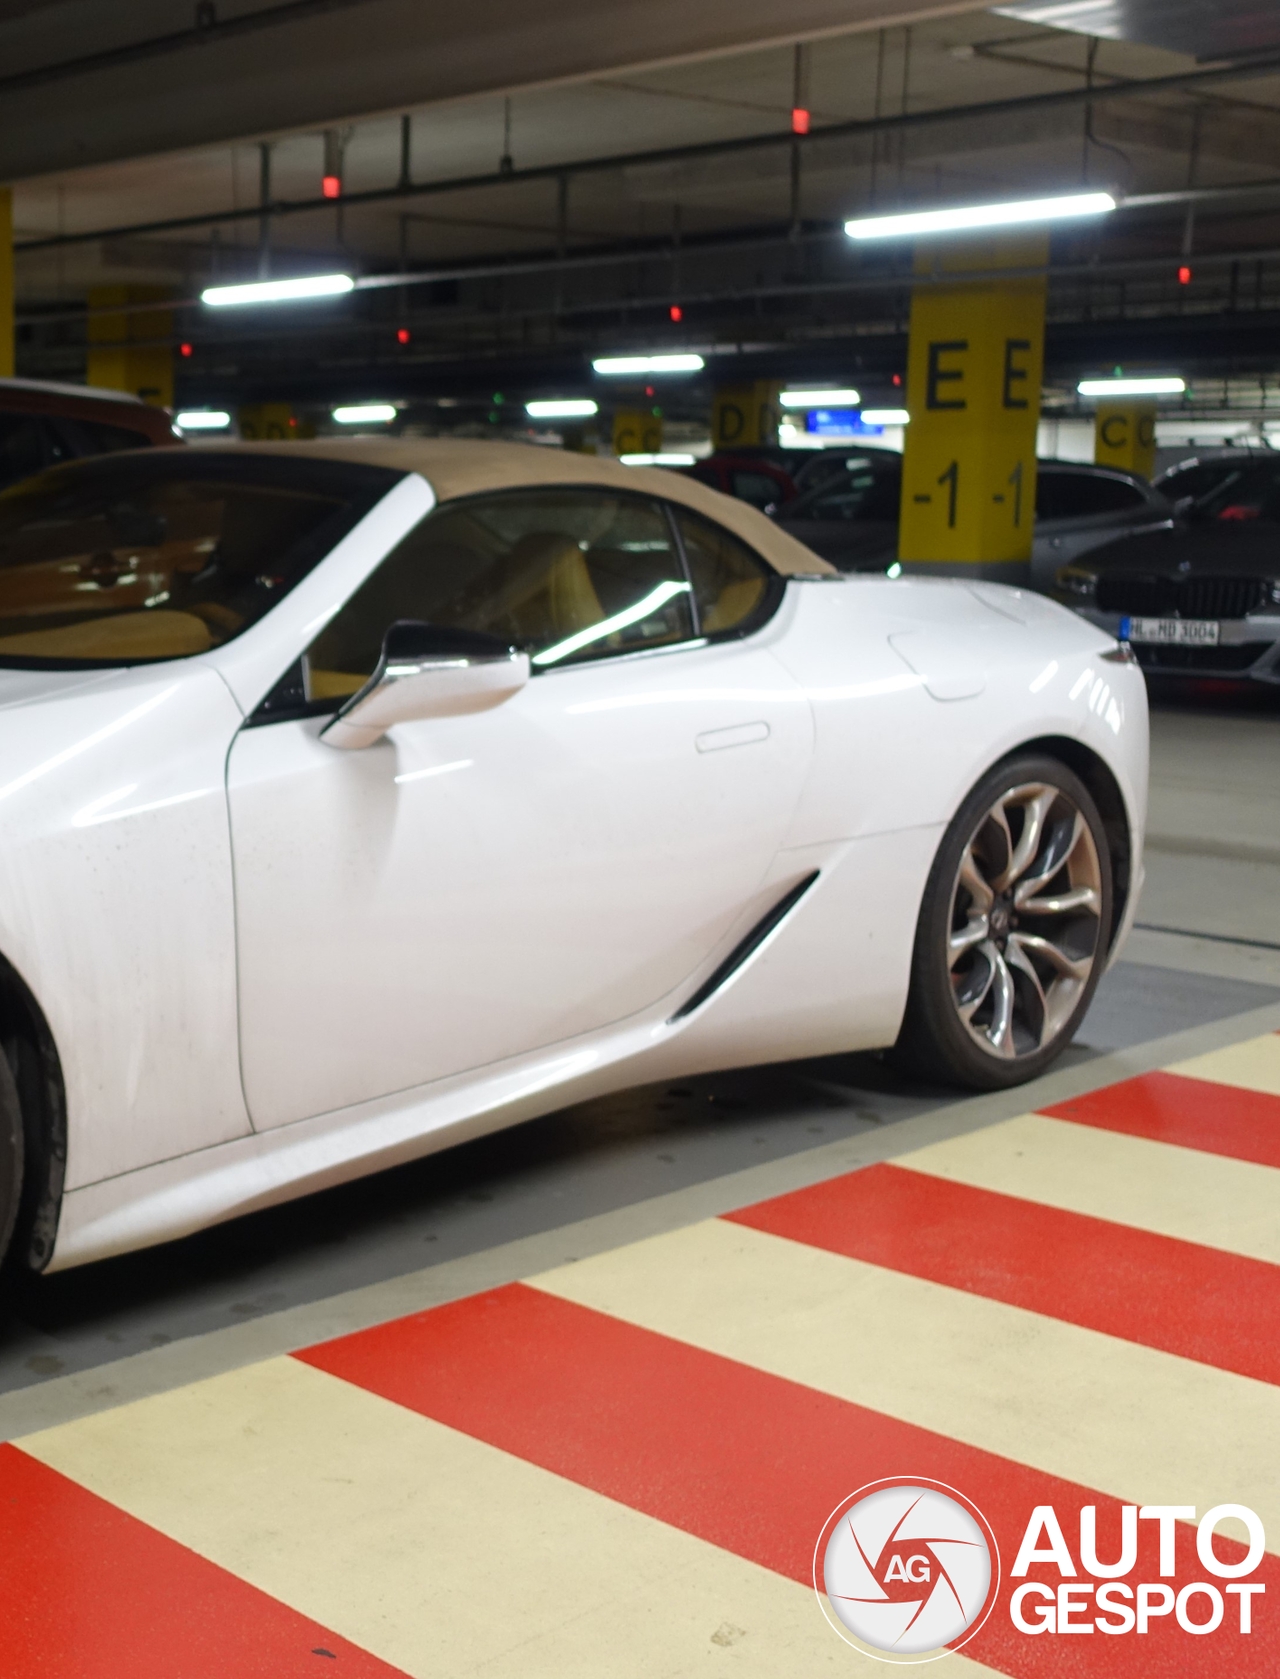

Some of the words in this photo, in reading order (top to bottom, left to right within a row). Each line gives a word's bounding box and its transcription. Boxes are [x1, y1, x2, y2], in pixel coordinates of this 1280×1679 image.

[927, 341, 968, 409] E
[1004, 339, 1030, 408] E
[1101, 415, 1126, 447] C
[915, 462, 957, 527] -1
[994, 461, 1022, 527] -1
